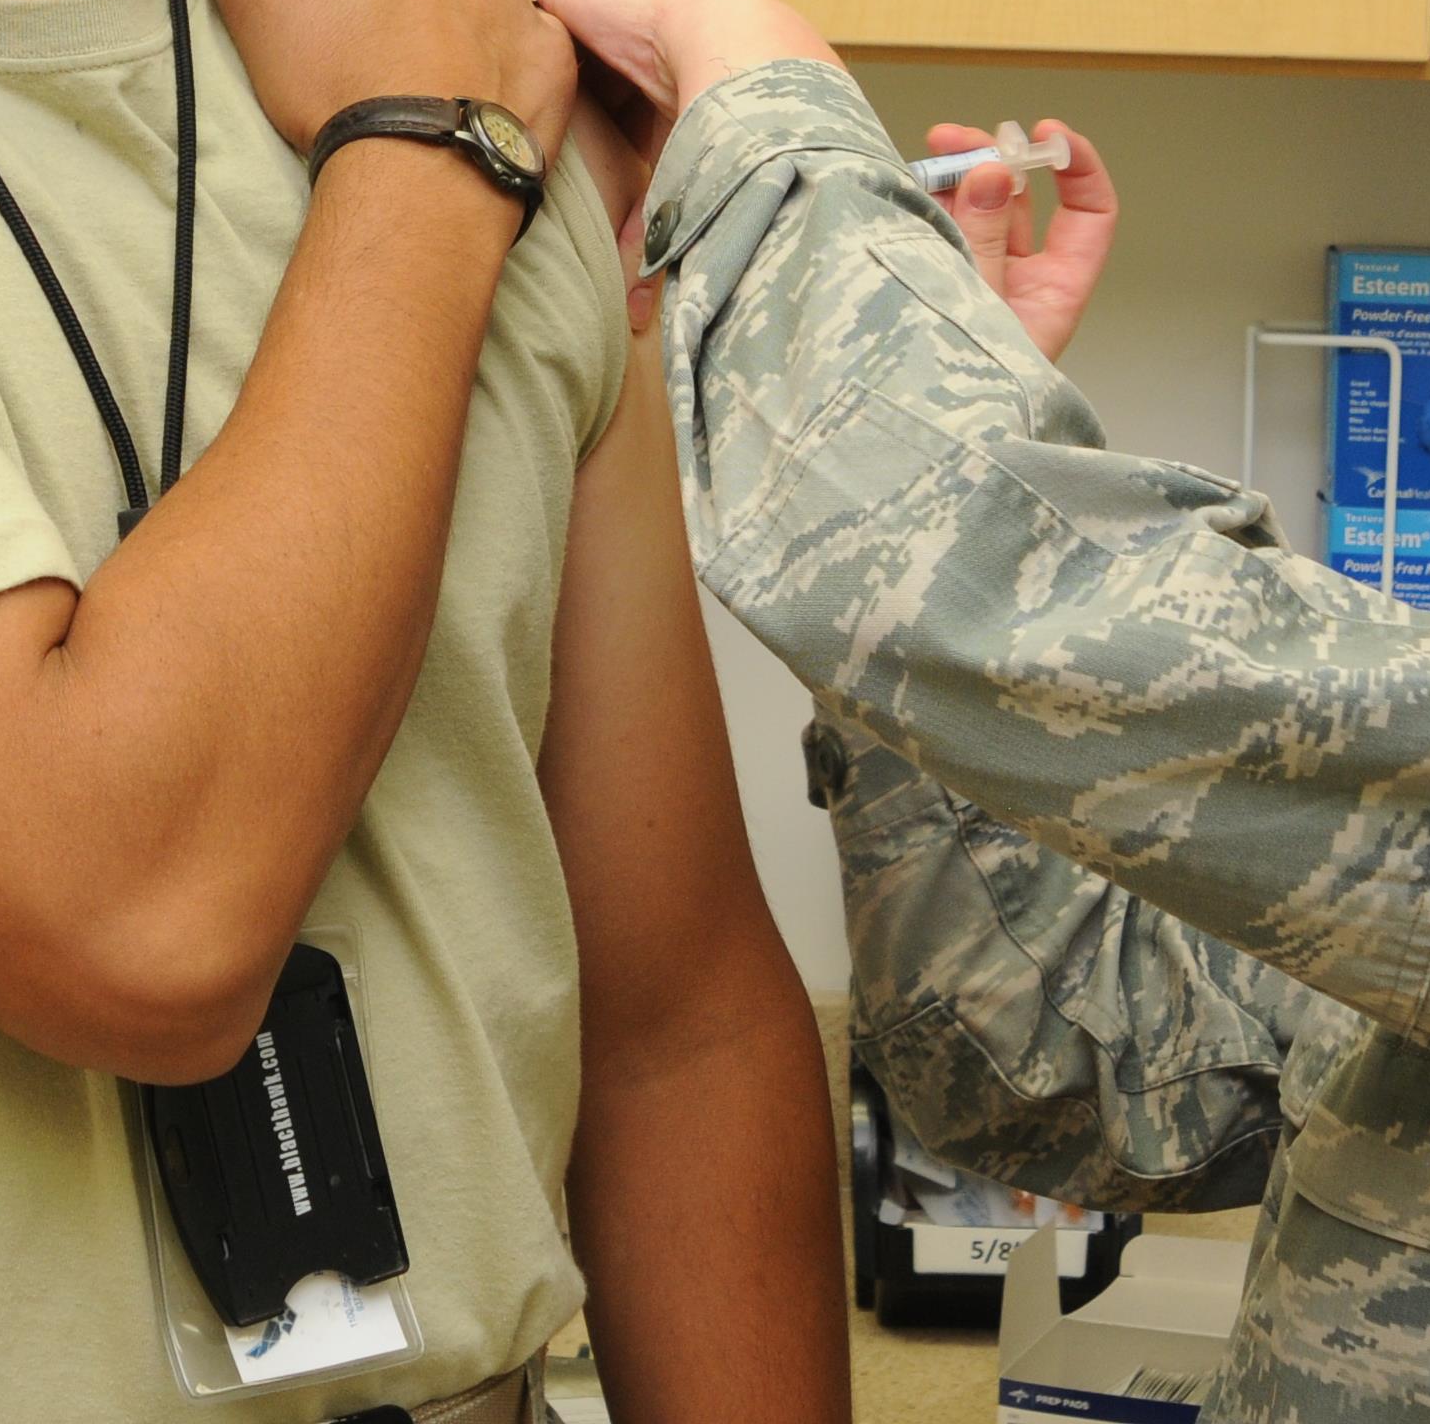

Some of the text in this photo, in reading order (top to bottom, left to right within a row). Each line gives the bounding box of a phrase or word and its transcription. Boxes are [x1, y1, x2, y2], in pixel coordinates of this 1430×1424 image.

[1354, 262, 1399, 272] Textured
[1345, 513, 1384, 523] Texture
[256, 1031, 312, 1217] www.blackhawk.com
[1035, 1394, 1061, 1406] PREP
